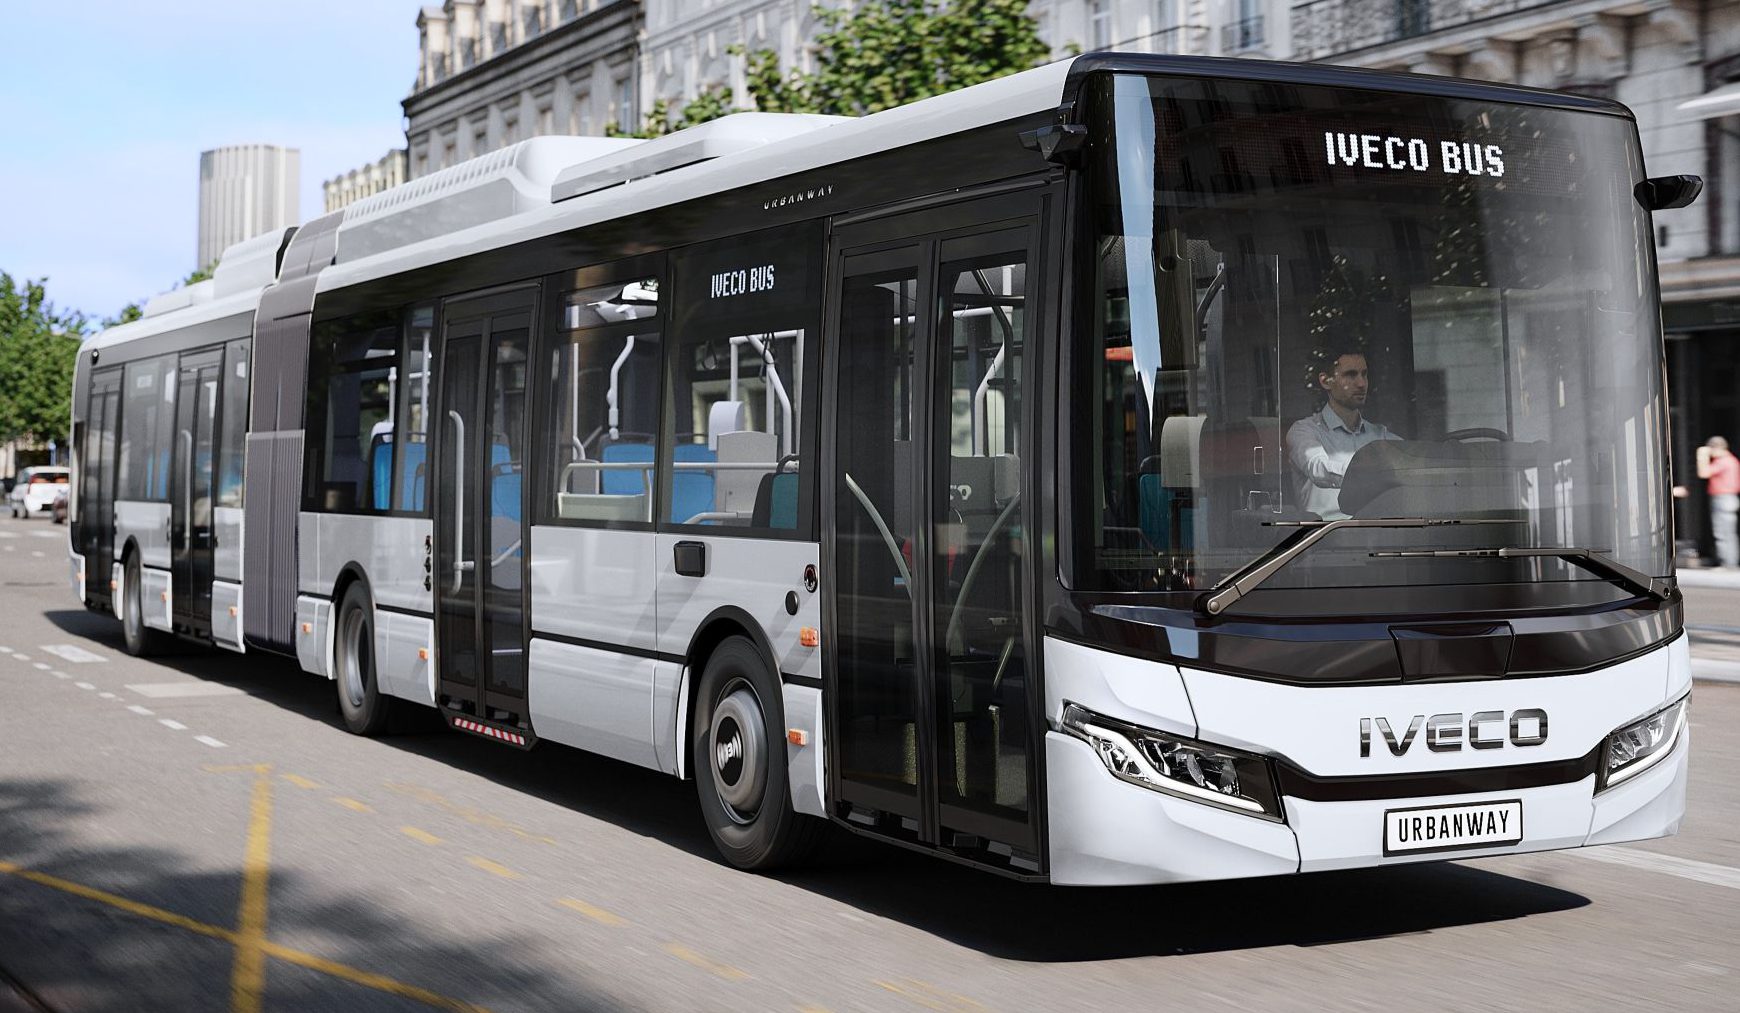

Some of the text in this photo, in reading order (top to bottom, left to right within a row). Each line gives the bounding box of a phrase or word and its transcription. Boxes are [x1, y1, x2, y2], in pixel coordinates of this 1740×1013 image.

[1325, 131, 1505, 177] IVECO BUS
[763, 184, 834, 210] URBANWAY
[711, 264, 775, 299] IVECO BUS
[1359, 707, 1549, 758] IVECO
[1398, 809, 1509, 843] URBANWAY
